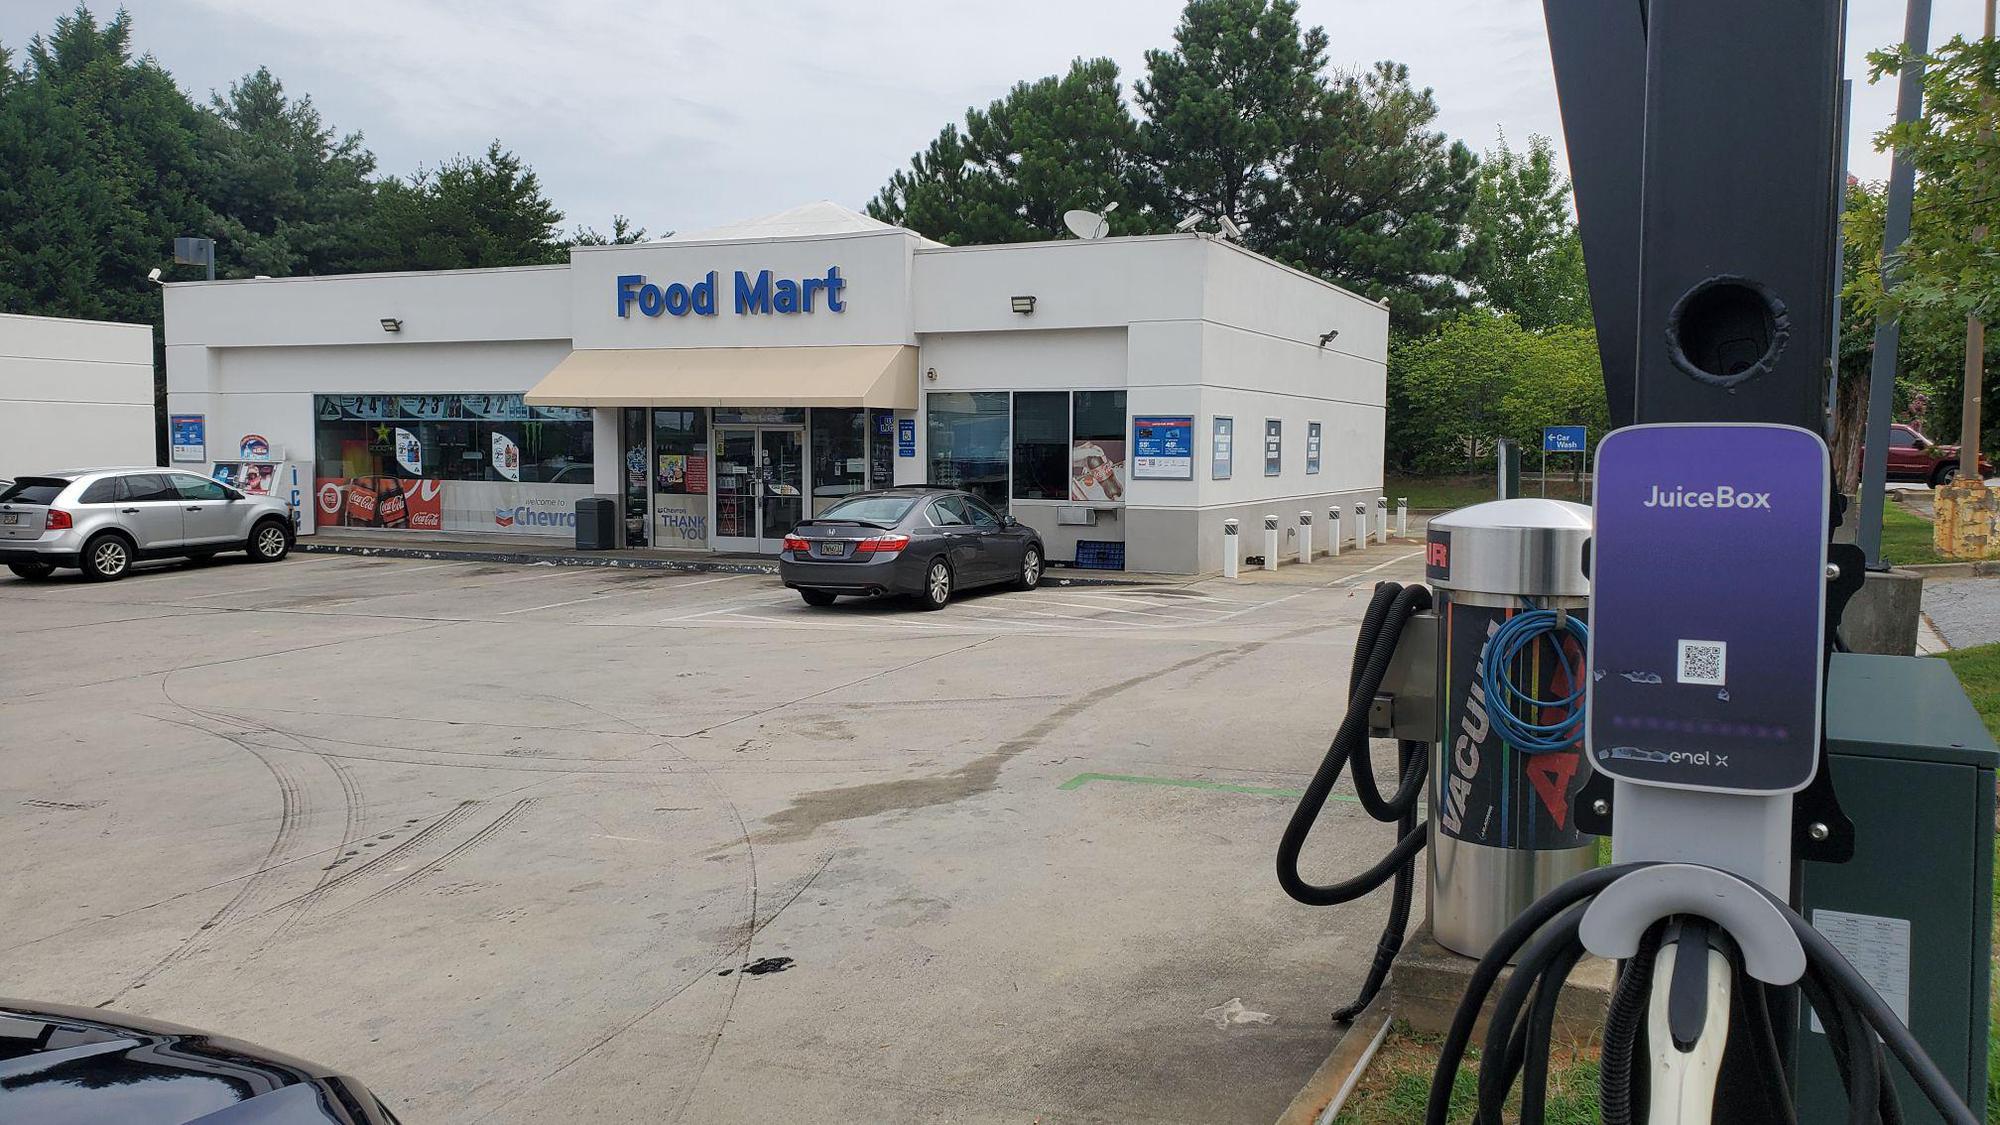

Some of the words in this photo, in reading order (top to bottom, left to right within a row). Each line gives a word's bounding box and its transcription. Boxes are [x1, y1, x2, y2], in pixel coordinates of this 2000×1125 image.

[617, 270, 719, 319] Food
[735, 266, 847, 317] Mart
[526, 498, 556, 506] welcome
[1643, 485, 1771, 508] JuiceBox
[515, 506, 576, 527] Chevro
[662, 515, 706, 528] THANK
[680, 528, 706, 540] YOU
[1428, 542, 1447, 568] IR
[1442, 618, 1501, 834] VACU
[1669, 751, 1710, 766] enel
